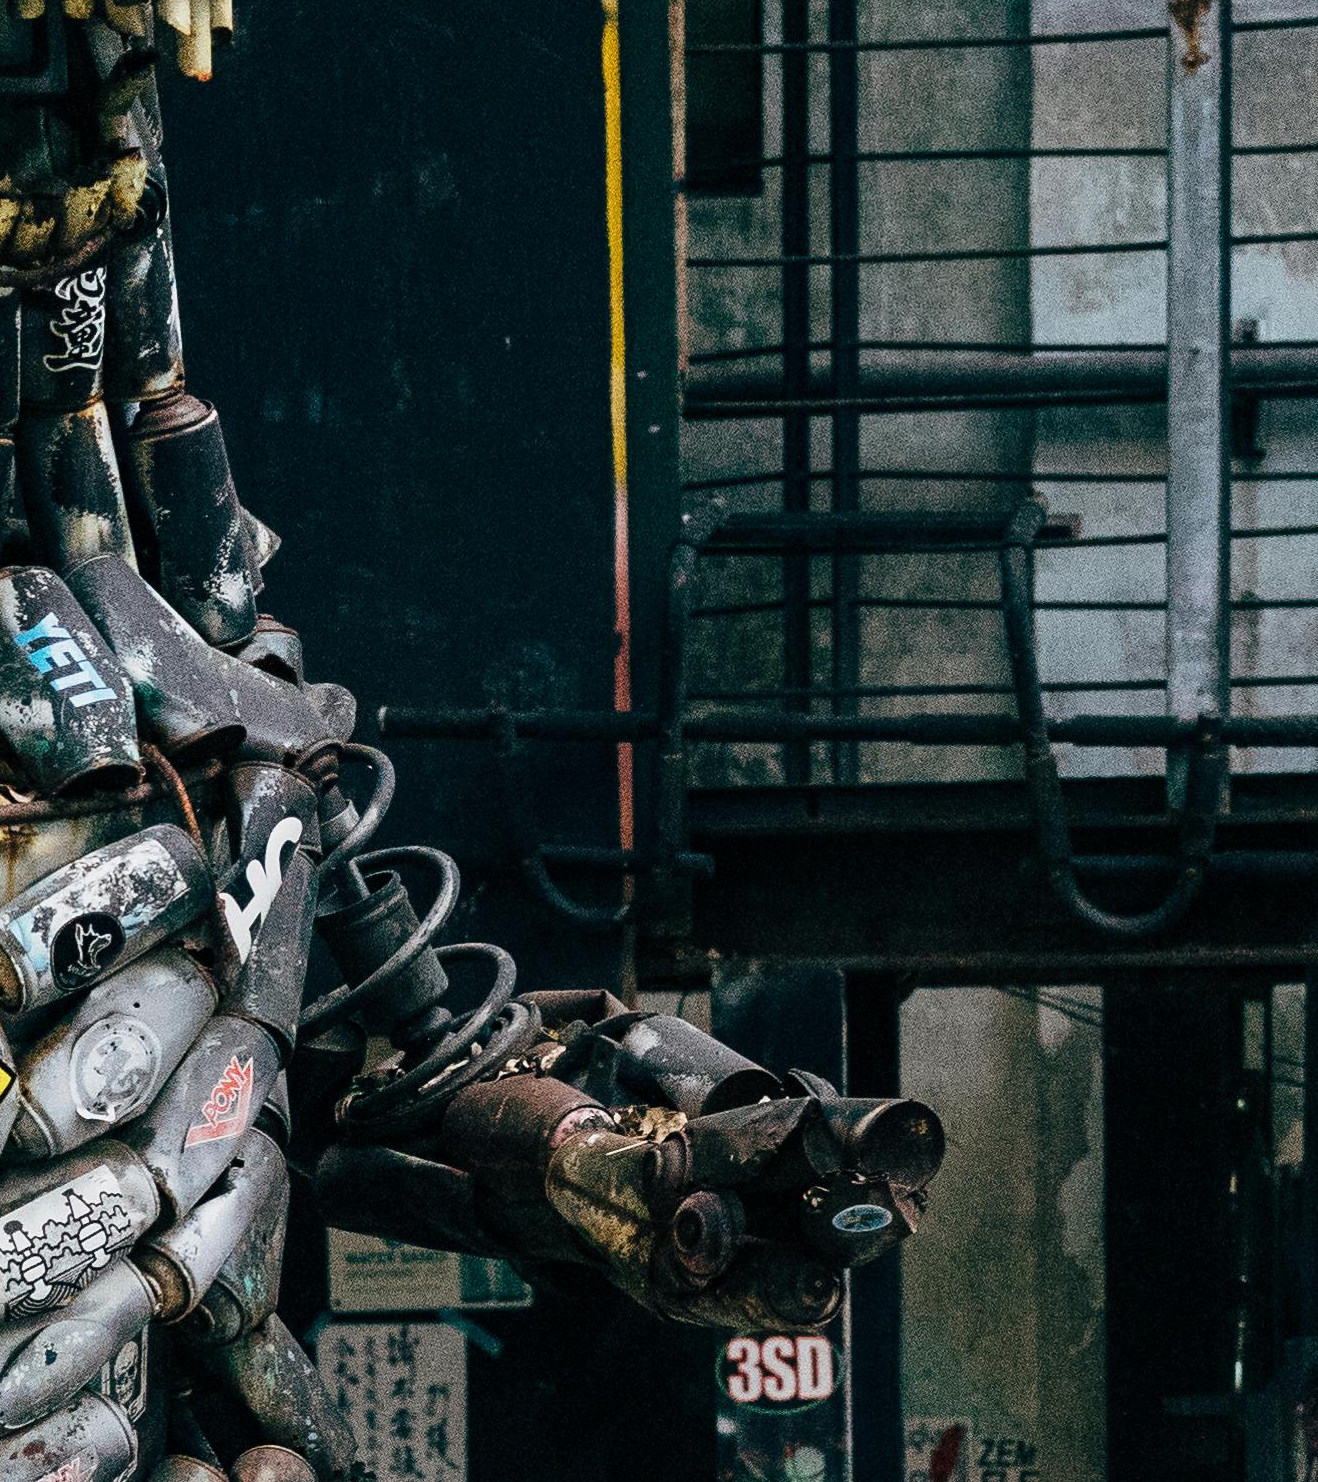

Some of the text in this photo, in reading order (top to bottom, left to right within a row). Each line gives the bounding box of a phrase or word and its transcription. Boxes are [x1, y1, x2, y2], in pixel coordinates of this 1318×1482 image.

[15, 612, 116, 706] YETI
[202, 1055, 254, 1129] PONY
[727, 1335, 834, 1402] 3SD
